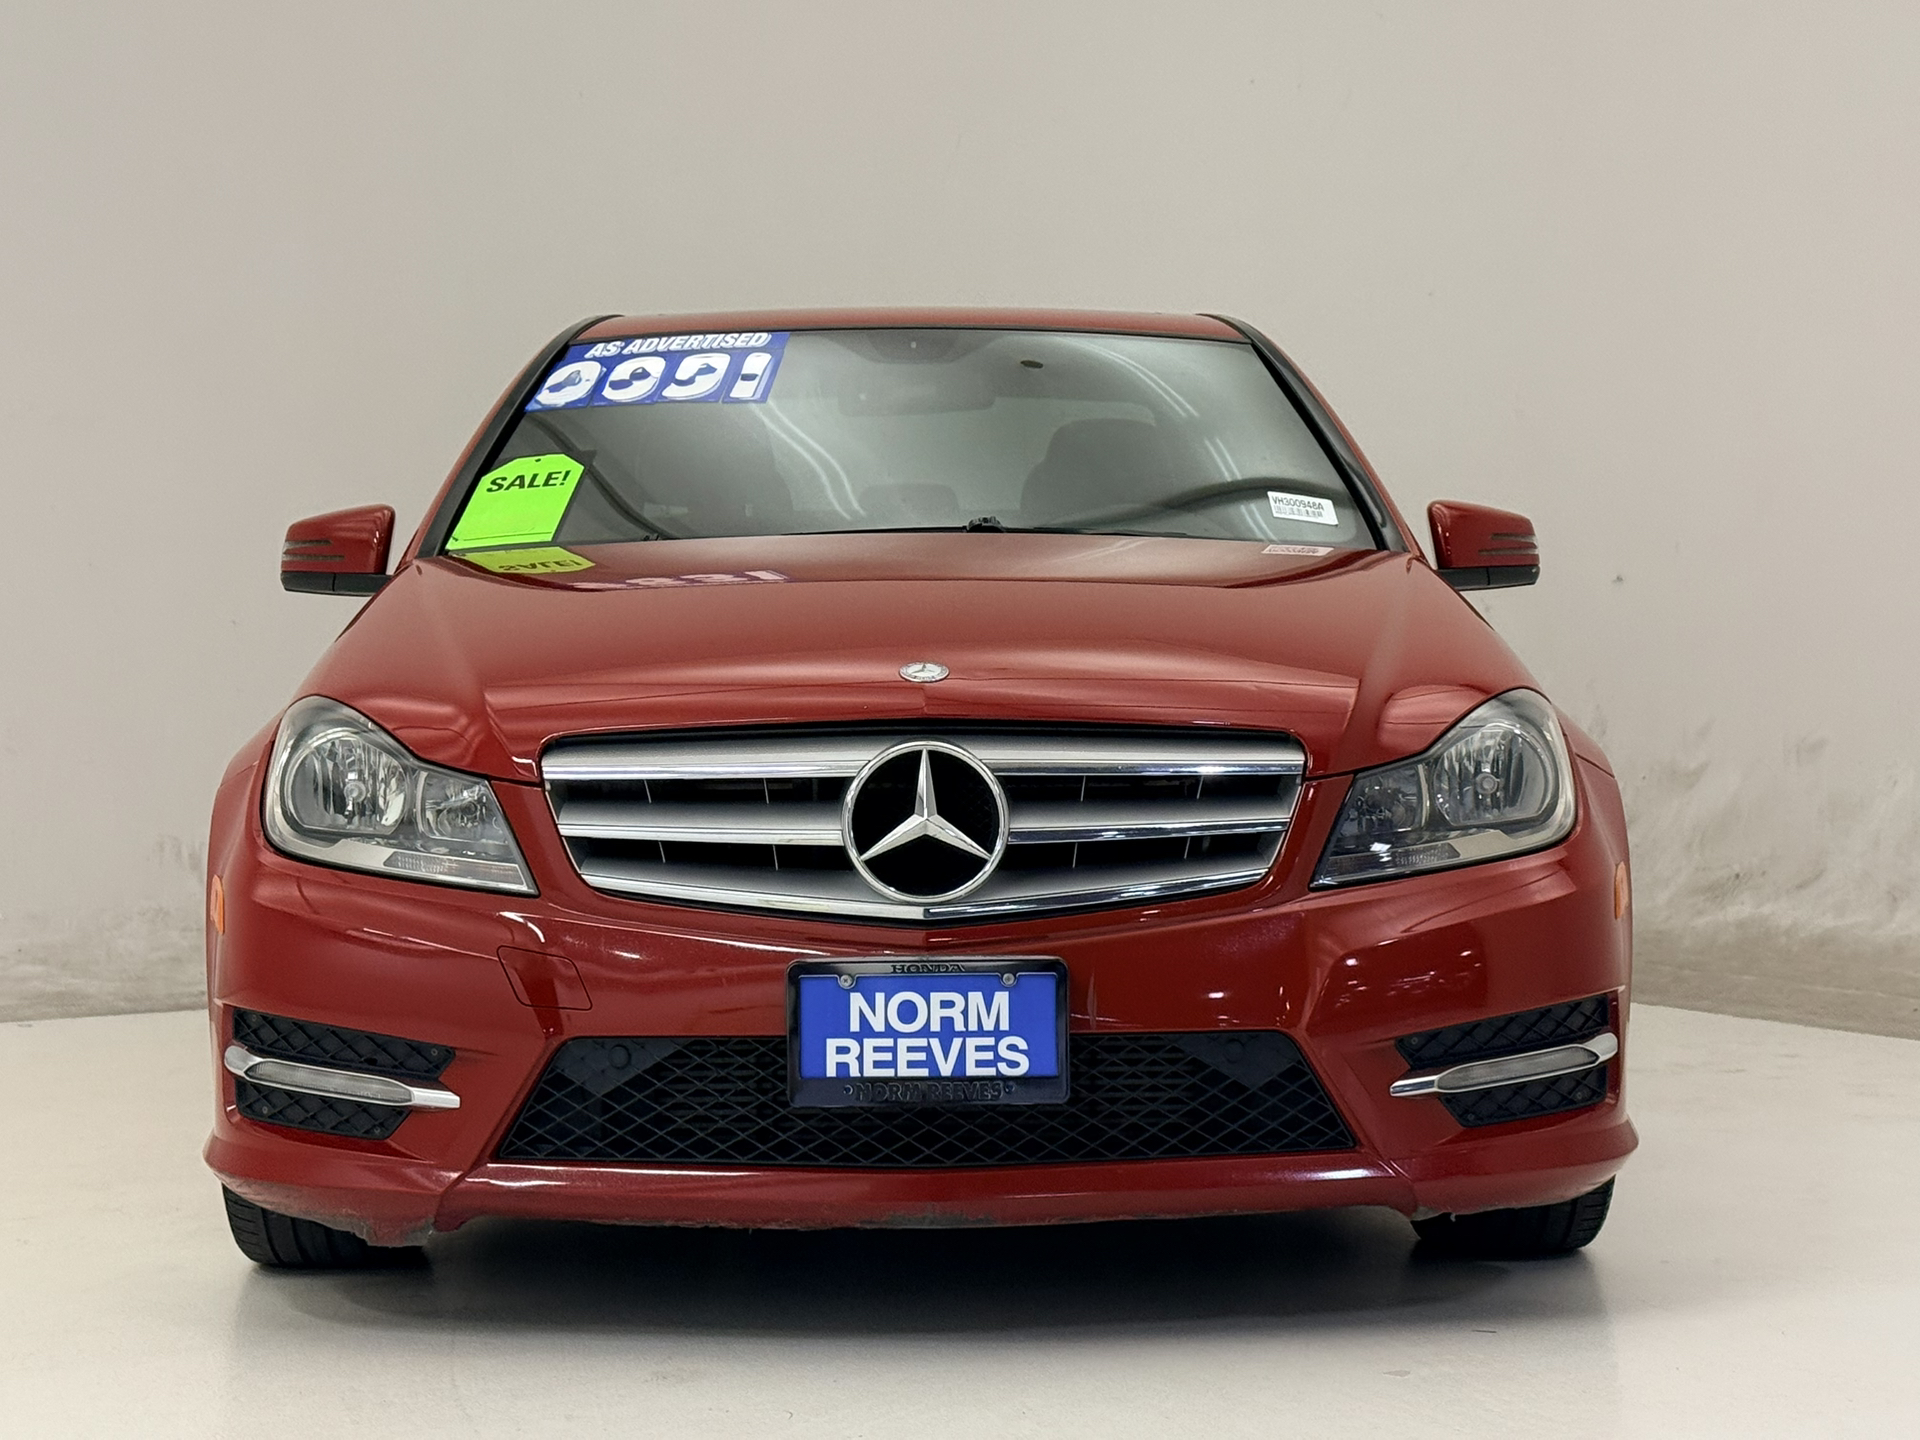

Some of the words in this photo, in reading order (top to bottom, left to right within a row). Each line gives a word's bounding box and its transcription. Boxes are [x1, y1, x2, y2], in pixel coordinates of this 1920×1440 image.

[584, 341, 625, 359] AS
[622, 332, 772, 354] ADVERTISED
[486, 470, 571, 493] SALE!
[890, 963, 965, 974] HONDA
[850, 991, 1010, 1033] NORM
[825, 1036, 1030, 1078] REEVES
[856, 1082, 922, 1101] NORM
[927, 1081, 1004, 1100] REEVES
